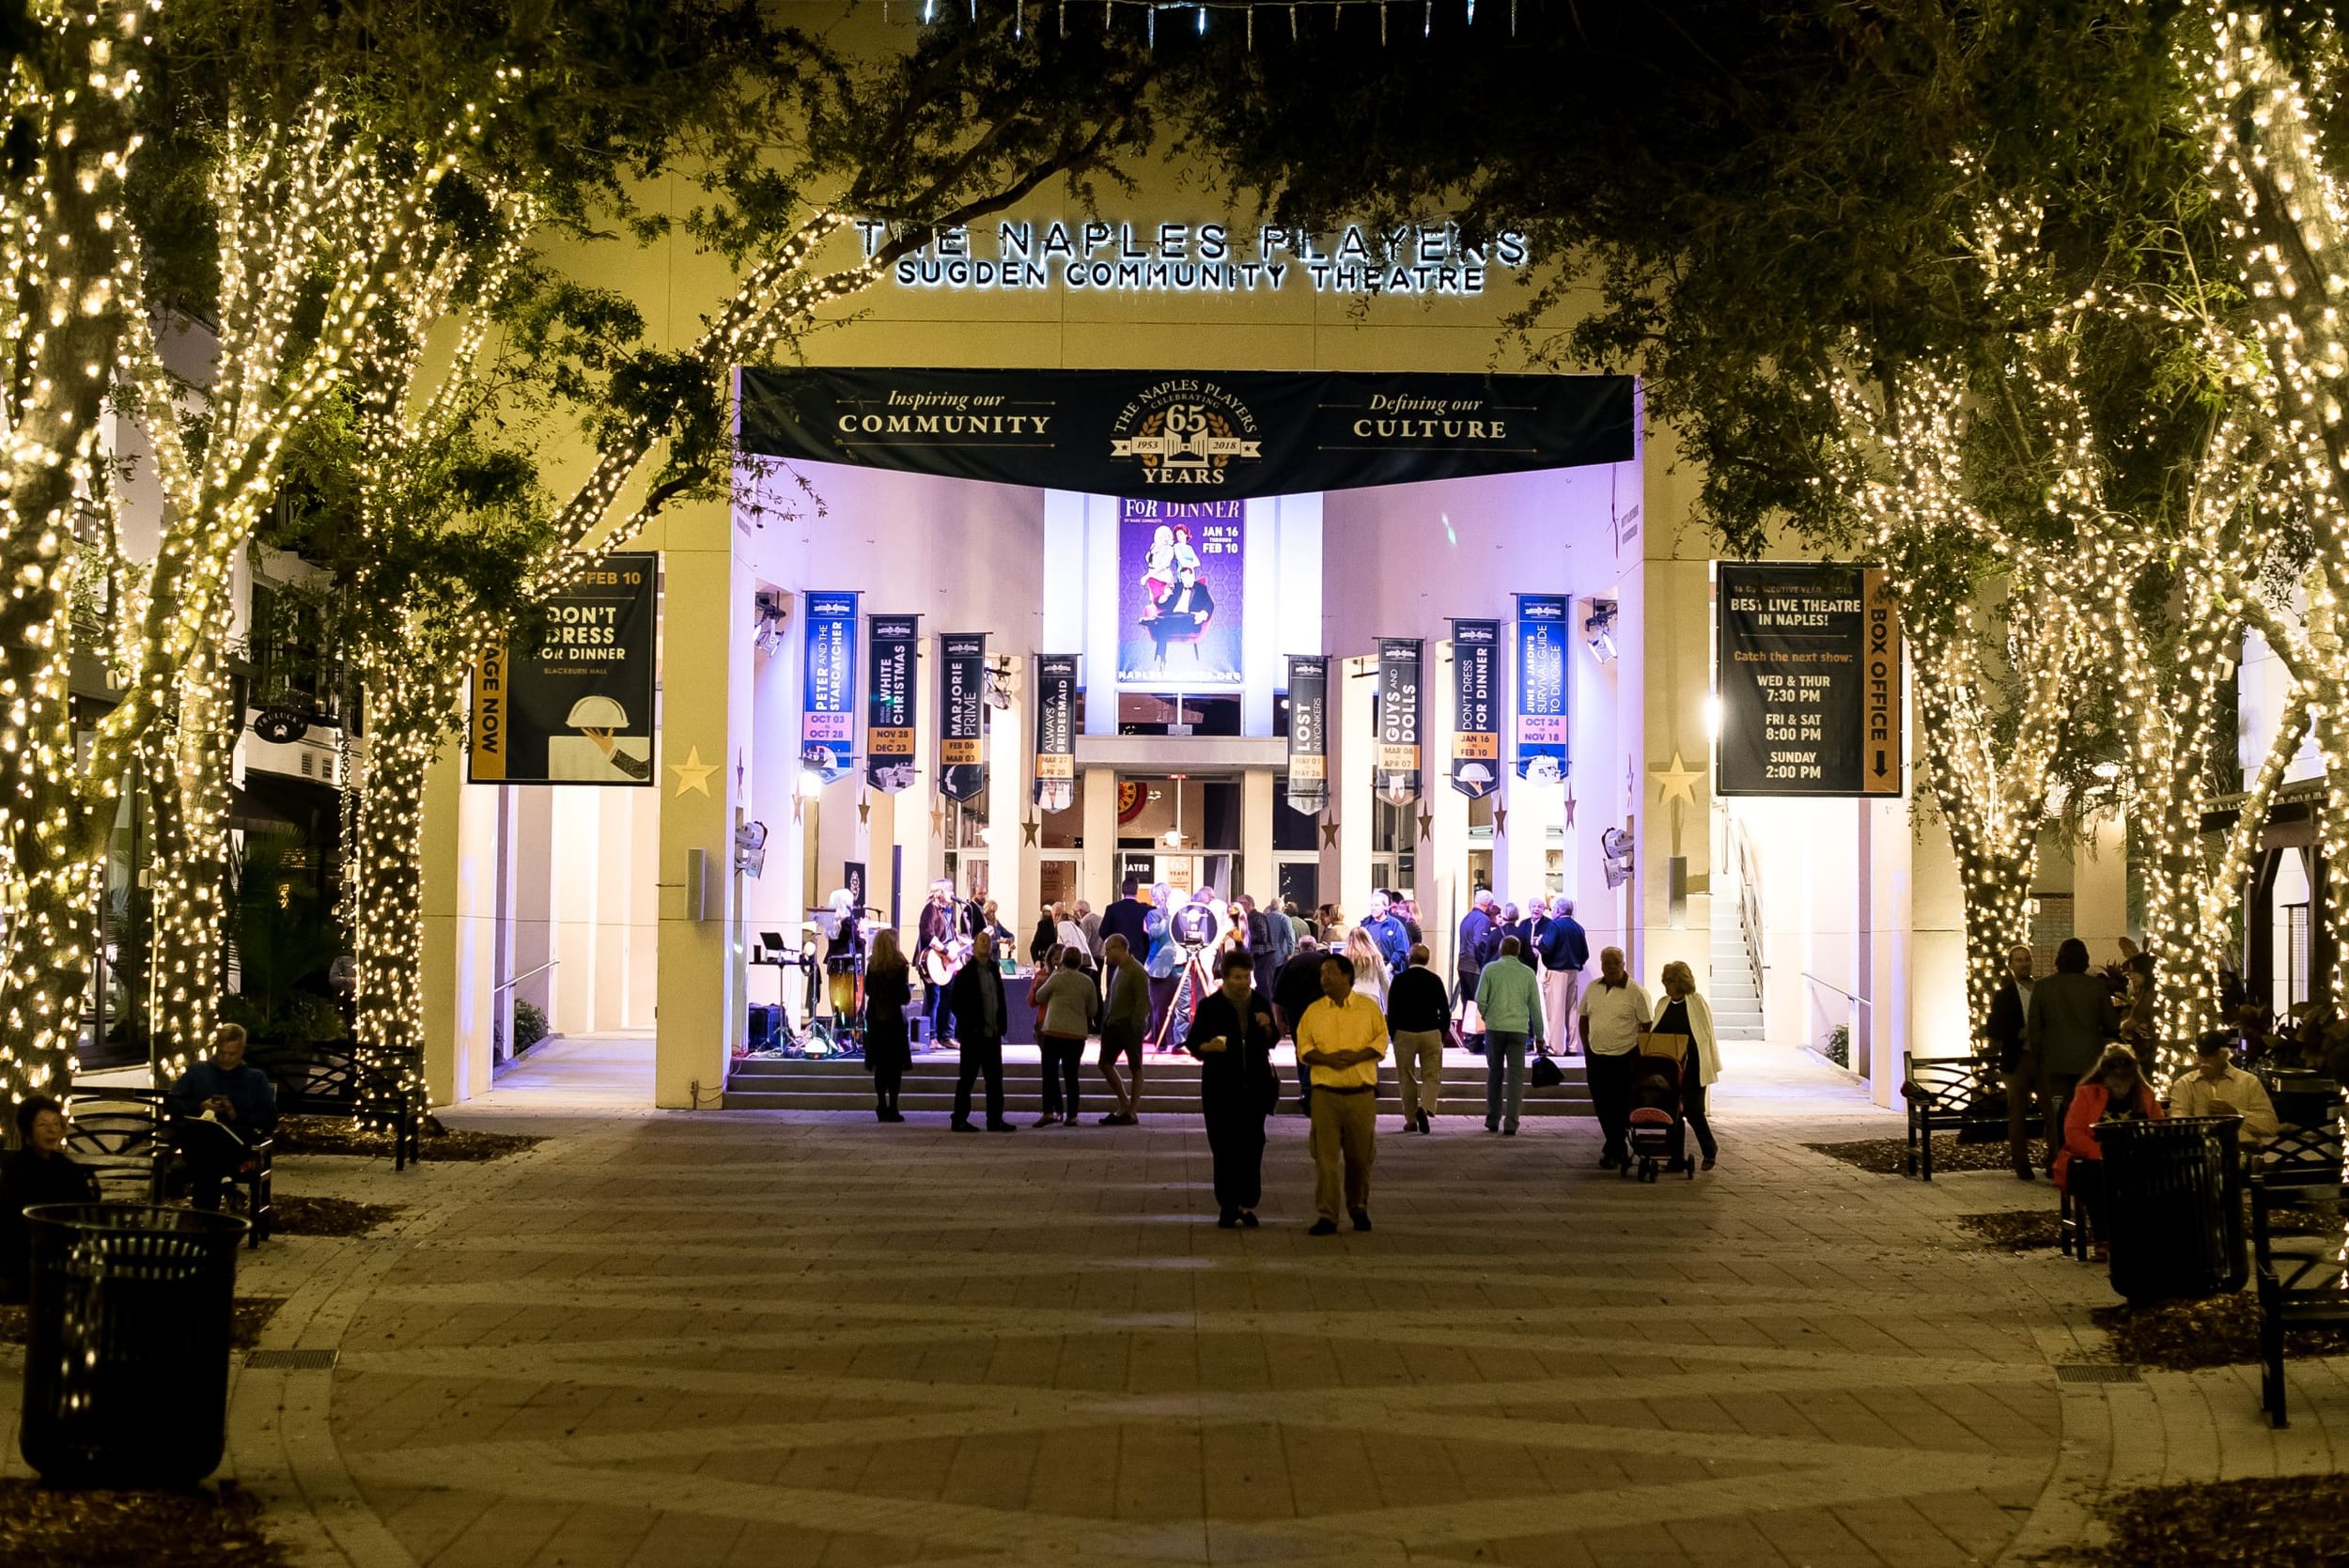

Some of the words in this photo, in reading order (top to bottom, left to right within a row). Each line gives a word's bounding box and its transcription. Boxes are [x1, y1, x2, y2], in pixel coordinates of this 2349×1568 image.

[856, 220, 966, 258] TE
[1001, 222, 1226, 259] NAPLES
[896, 259, 1046, 286] SUGDEN
[1066, 262, 1284, 290] COMMUNITY
[1310, 265, 1484, 292] THEATRE
[887, 389, 969, 412] Inspiring
[973, 395, 1005, 408] our
[1114, 402, 1140, 432] THE
[1139, 380, 1200, 404] NAPLES
[1205, 383, 1258, 434] PLAYERS
[1150, 393, 1221, 410] CELEBRATING
[1369, 393, 1446, 416] Defining
[1452, 400, 1484, 411] our
[838, 413, 1050, 435] COMMUNITY
[1166, 404, 1207, 432] 65
[1353, 419, 1507, 439] CULTURE
[1137, 441, 1159, 449] 1953
[1212, 442, 1237, 450] 2018
[1142, 468, 1225, 485] YEARS
[1165, 501, 1240, 519] DINNER
[1203, 526, 1223, 537] JAN
[1226, 527, 1238, 537] 16
[1203, 543, 1222, 554] FEB
[1226, 543, 1238, 554] 10
[586, 571, 617, 585] FEB
[623, 571, 641, 584] 10
[546, 606, 616, 625] DON'T
[1768, 598, 1798, 613] LIVE
[1802, 599, 1861, 613] THEATRE
[1758, 614, 1772, 626] IN
[1776, 614, 1828, 627] NAPLES!
[1870, 608, 1888, 656] BOX
[545, 627, 615, 644] DRESS
[819, 625, 828, 643] THE
[1537, 625, 1548, 660] GUIDE
[482, 631, 500, 691] TAGE
[569, 648, 626, 660] DINNER
[818, 644, 827, 664] AND
[1527, 635, 1535, 675] JASON'S
[1735, 651, 1766, 661] Catch
[1769, 652, 1789, 662] the
[1792, 653, 1817, 662] next
[1820, 652, 1853, 662] show:
[830, 621, 843, 711] STARCATCHER
[1463, 660, 1473, 691] DRESS
[1476, 647, 1487, 697] DINNER
[1550, 645, 1561, 695] DIVORCE
[816, 668, 828, 710] PETER
[879, 659, 892, 702] WHITE
[893, 645, 906, 725] CHRISTMAS
[1390, 669, 1398, 689] AND
[1537, 662, 1548, 713] SURVIVAL
[1757, 675, 1783, 687] WED
[1787, 675, 1796, 687] &
[1799, 675, 1830, 687] THUR
[951, 662, 963, 736] MARJORIE
[1048, 695, 1056, 705] A
[1550, 698, 1561, 713] TO
[1766, 690, 1796, 702] 7:30
[1799, 690, 1820, 702] PM
[1870, 660, 1888, 741] OFFICE
[963, 691, 976, 736] PRIME
[1056, 679, 1068, 753] BRIDESMAID
[1314, 697, 1322, 738] YONKERS
[1386, 691, 1401, 742] GUYS
[1402, 684, 1416, 742] DOLLS
[1463, 695, 1472, 730] DON'T
[1476, 703, 1487, 731] FOR
[1526, 718, 1546, 726] OCT
[1548, 718, 1559, 726] 24
[1766, 714, 1784, 725] FRI
[1788, 714, 1797, 725] &
[1800, 714, 1822, 725] SAT
[481, 698, 499, 754] NOW
[1045, 707, 1056, 753] ALWAYS
[1297, 704, 1311, 752] LOST
[1766, 728, 1797, 740] 8:00
[1800, 728, 1822, 740] PM
[1314, 740, 1321, 752] IN
[1770, 752, 1817, 763] SUNDAY
[1766, 766, 1797, 778] 2:00
[1800, 767, 1821, 779] PM
